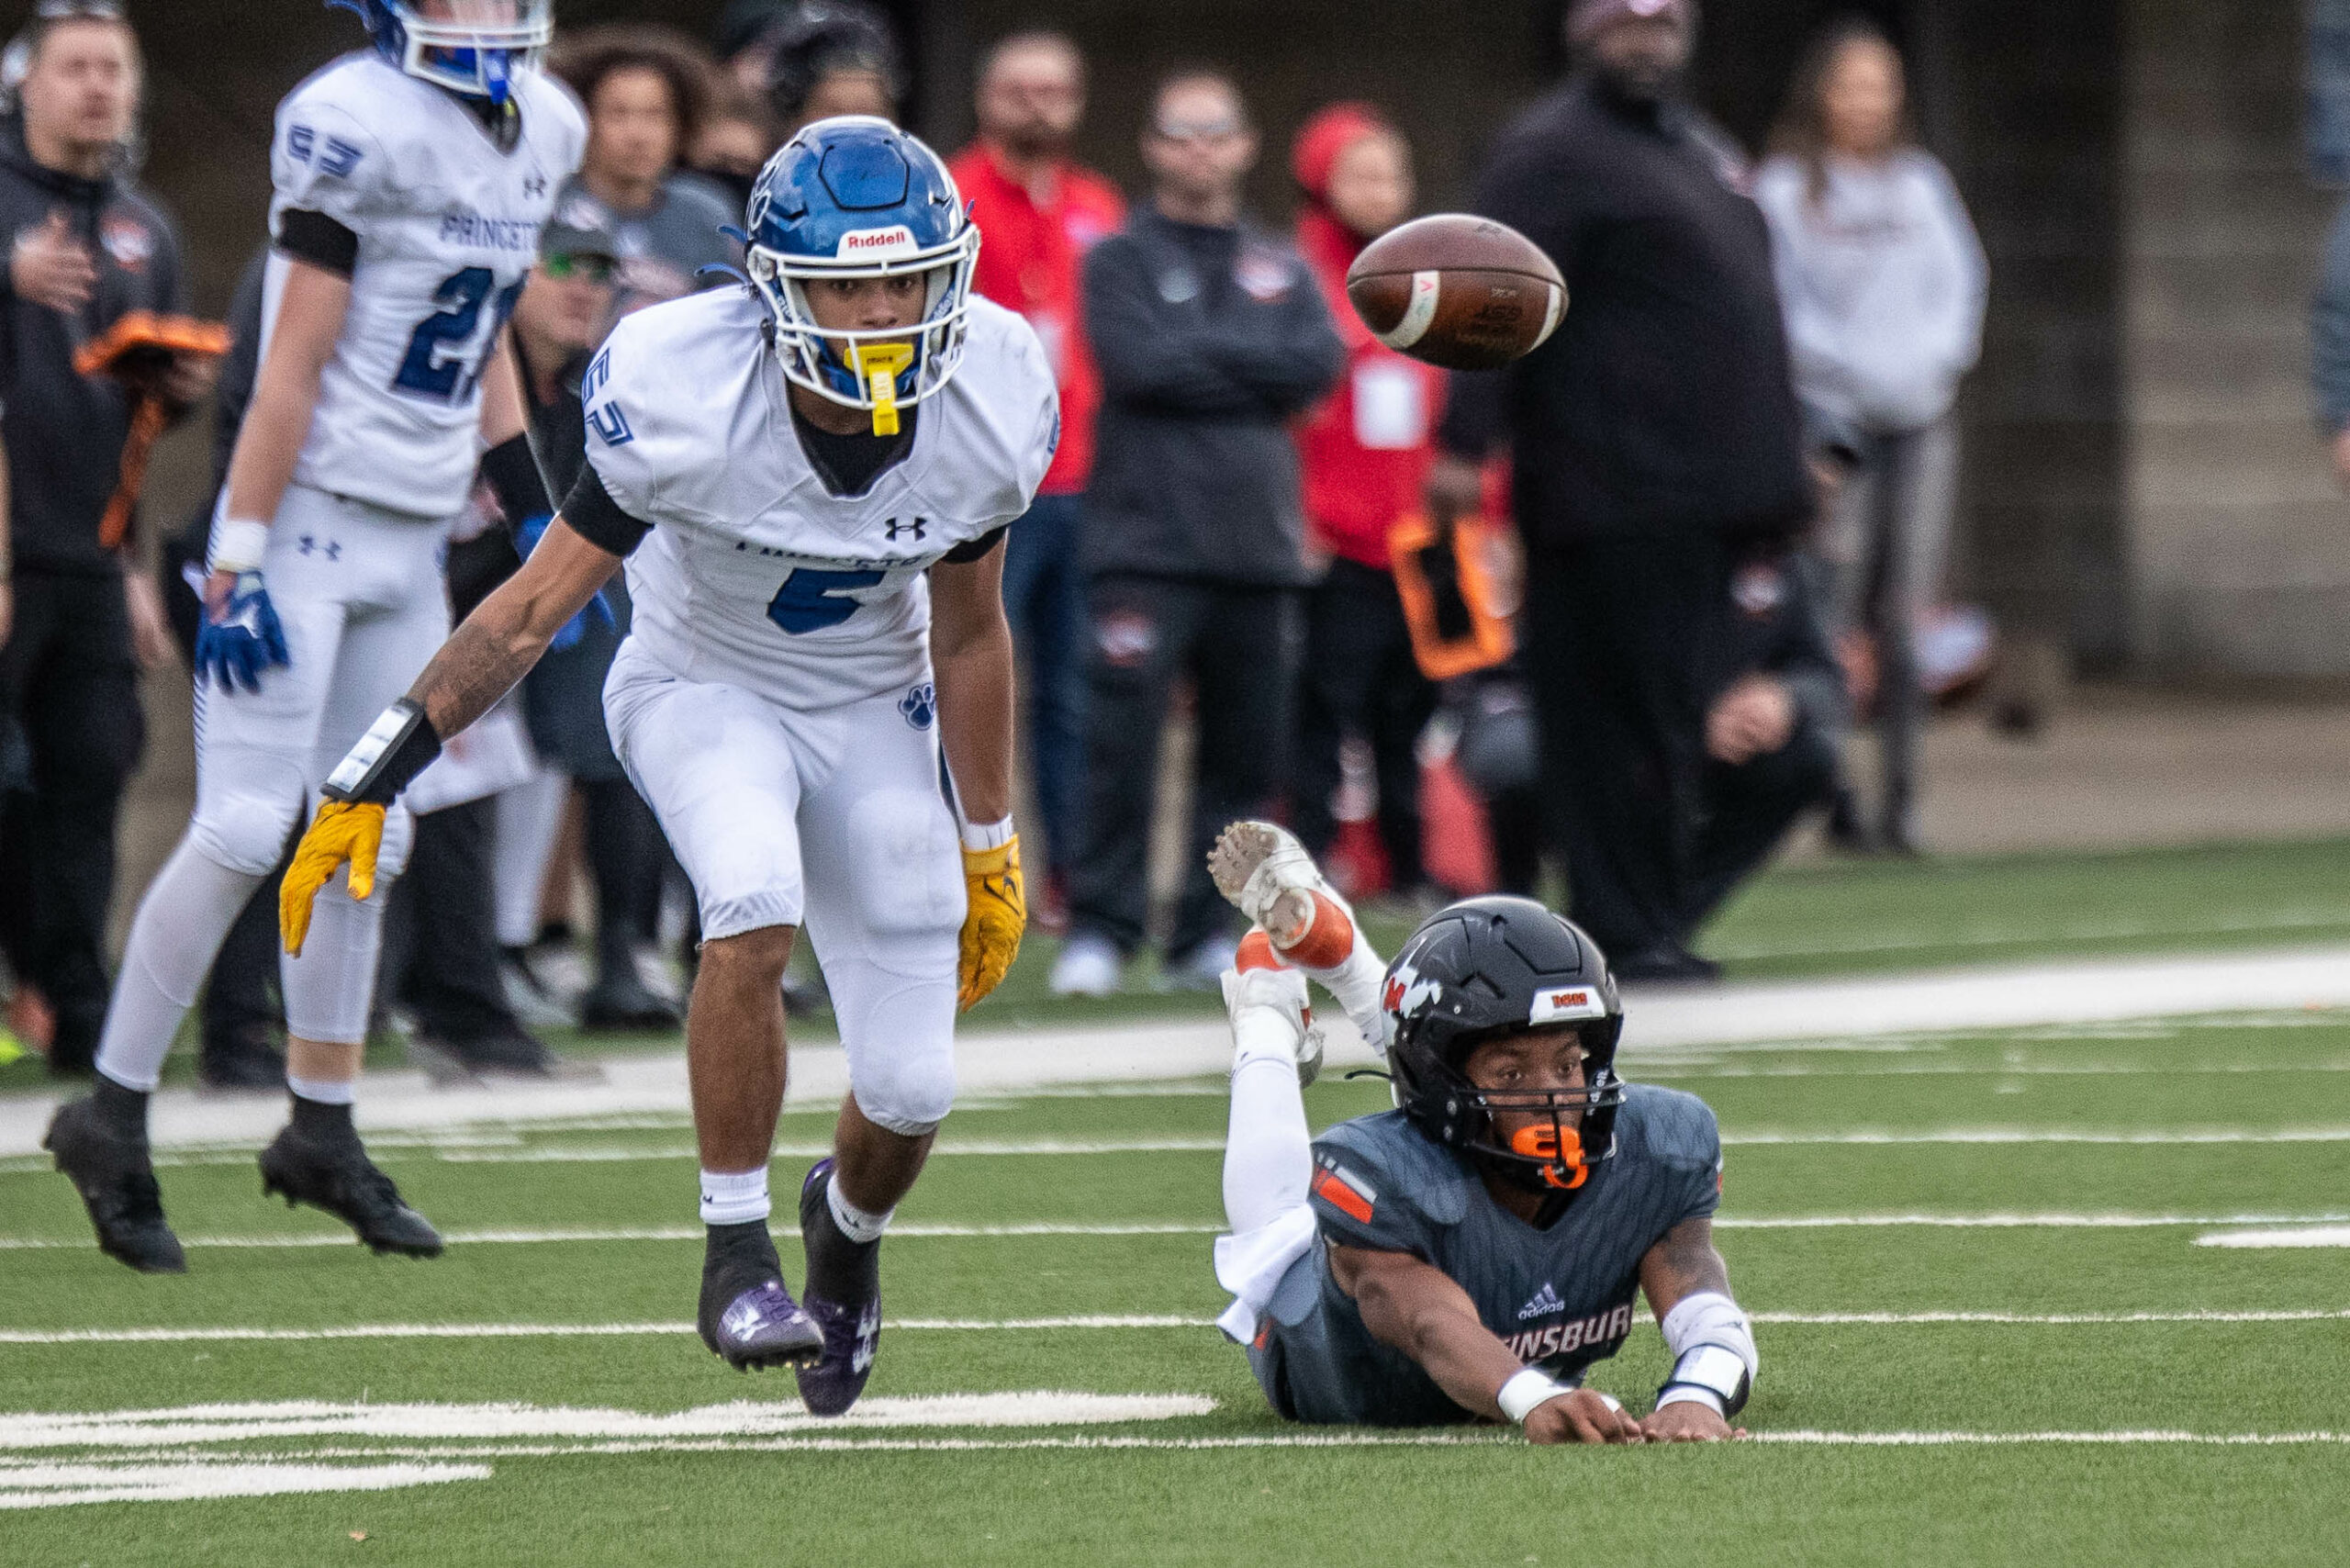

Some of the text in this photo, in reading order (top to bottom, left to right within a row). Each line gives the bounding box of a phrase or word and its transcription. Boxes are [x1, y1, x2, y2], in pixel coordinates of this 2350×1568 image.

[848, 231, 905, 249] Riddell
[1517, 1300, 1565, 1320] adidas
[1505, 1304, 1631, 1359] INSBUR
